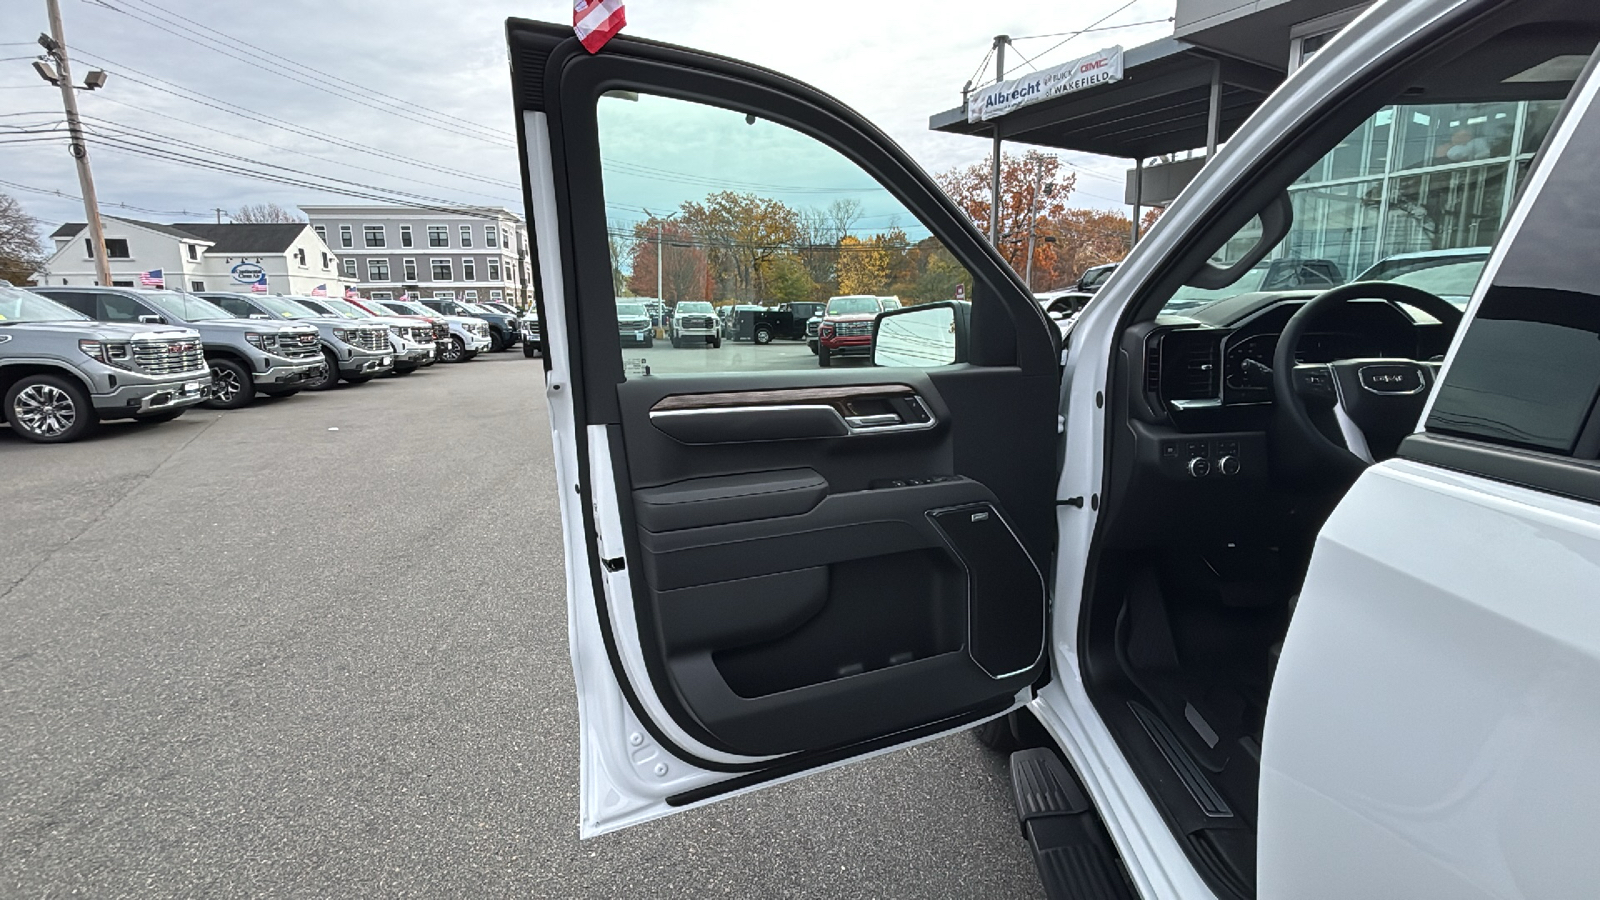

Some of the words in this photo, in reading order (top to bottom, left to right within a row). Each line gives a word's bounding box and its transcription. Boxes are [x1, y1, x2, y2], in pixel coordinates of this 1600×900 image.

[1052, 69, 1074, 83] BUICK
[1080, 57, 1108, 74] GMC
[1054, 71, 1109, 94] WAKEFIELD
[985, 81, 1041, 108] Albrecht
